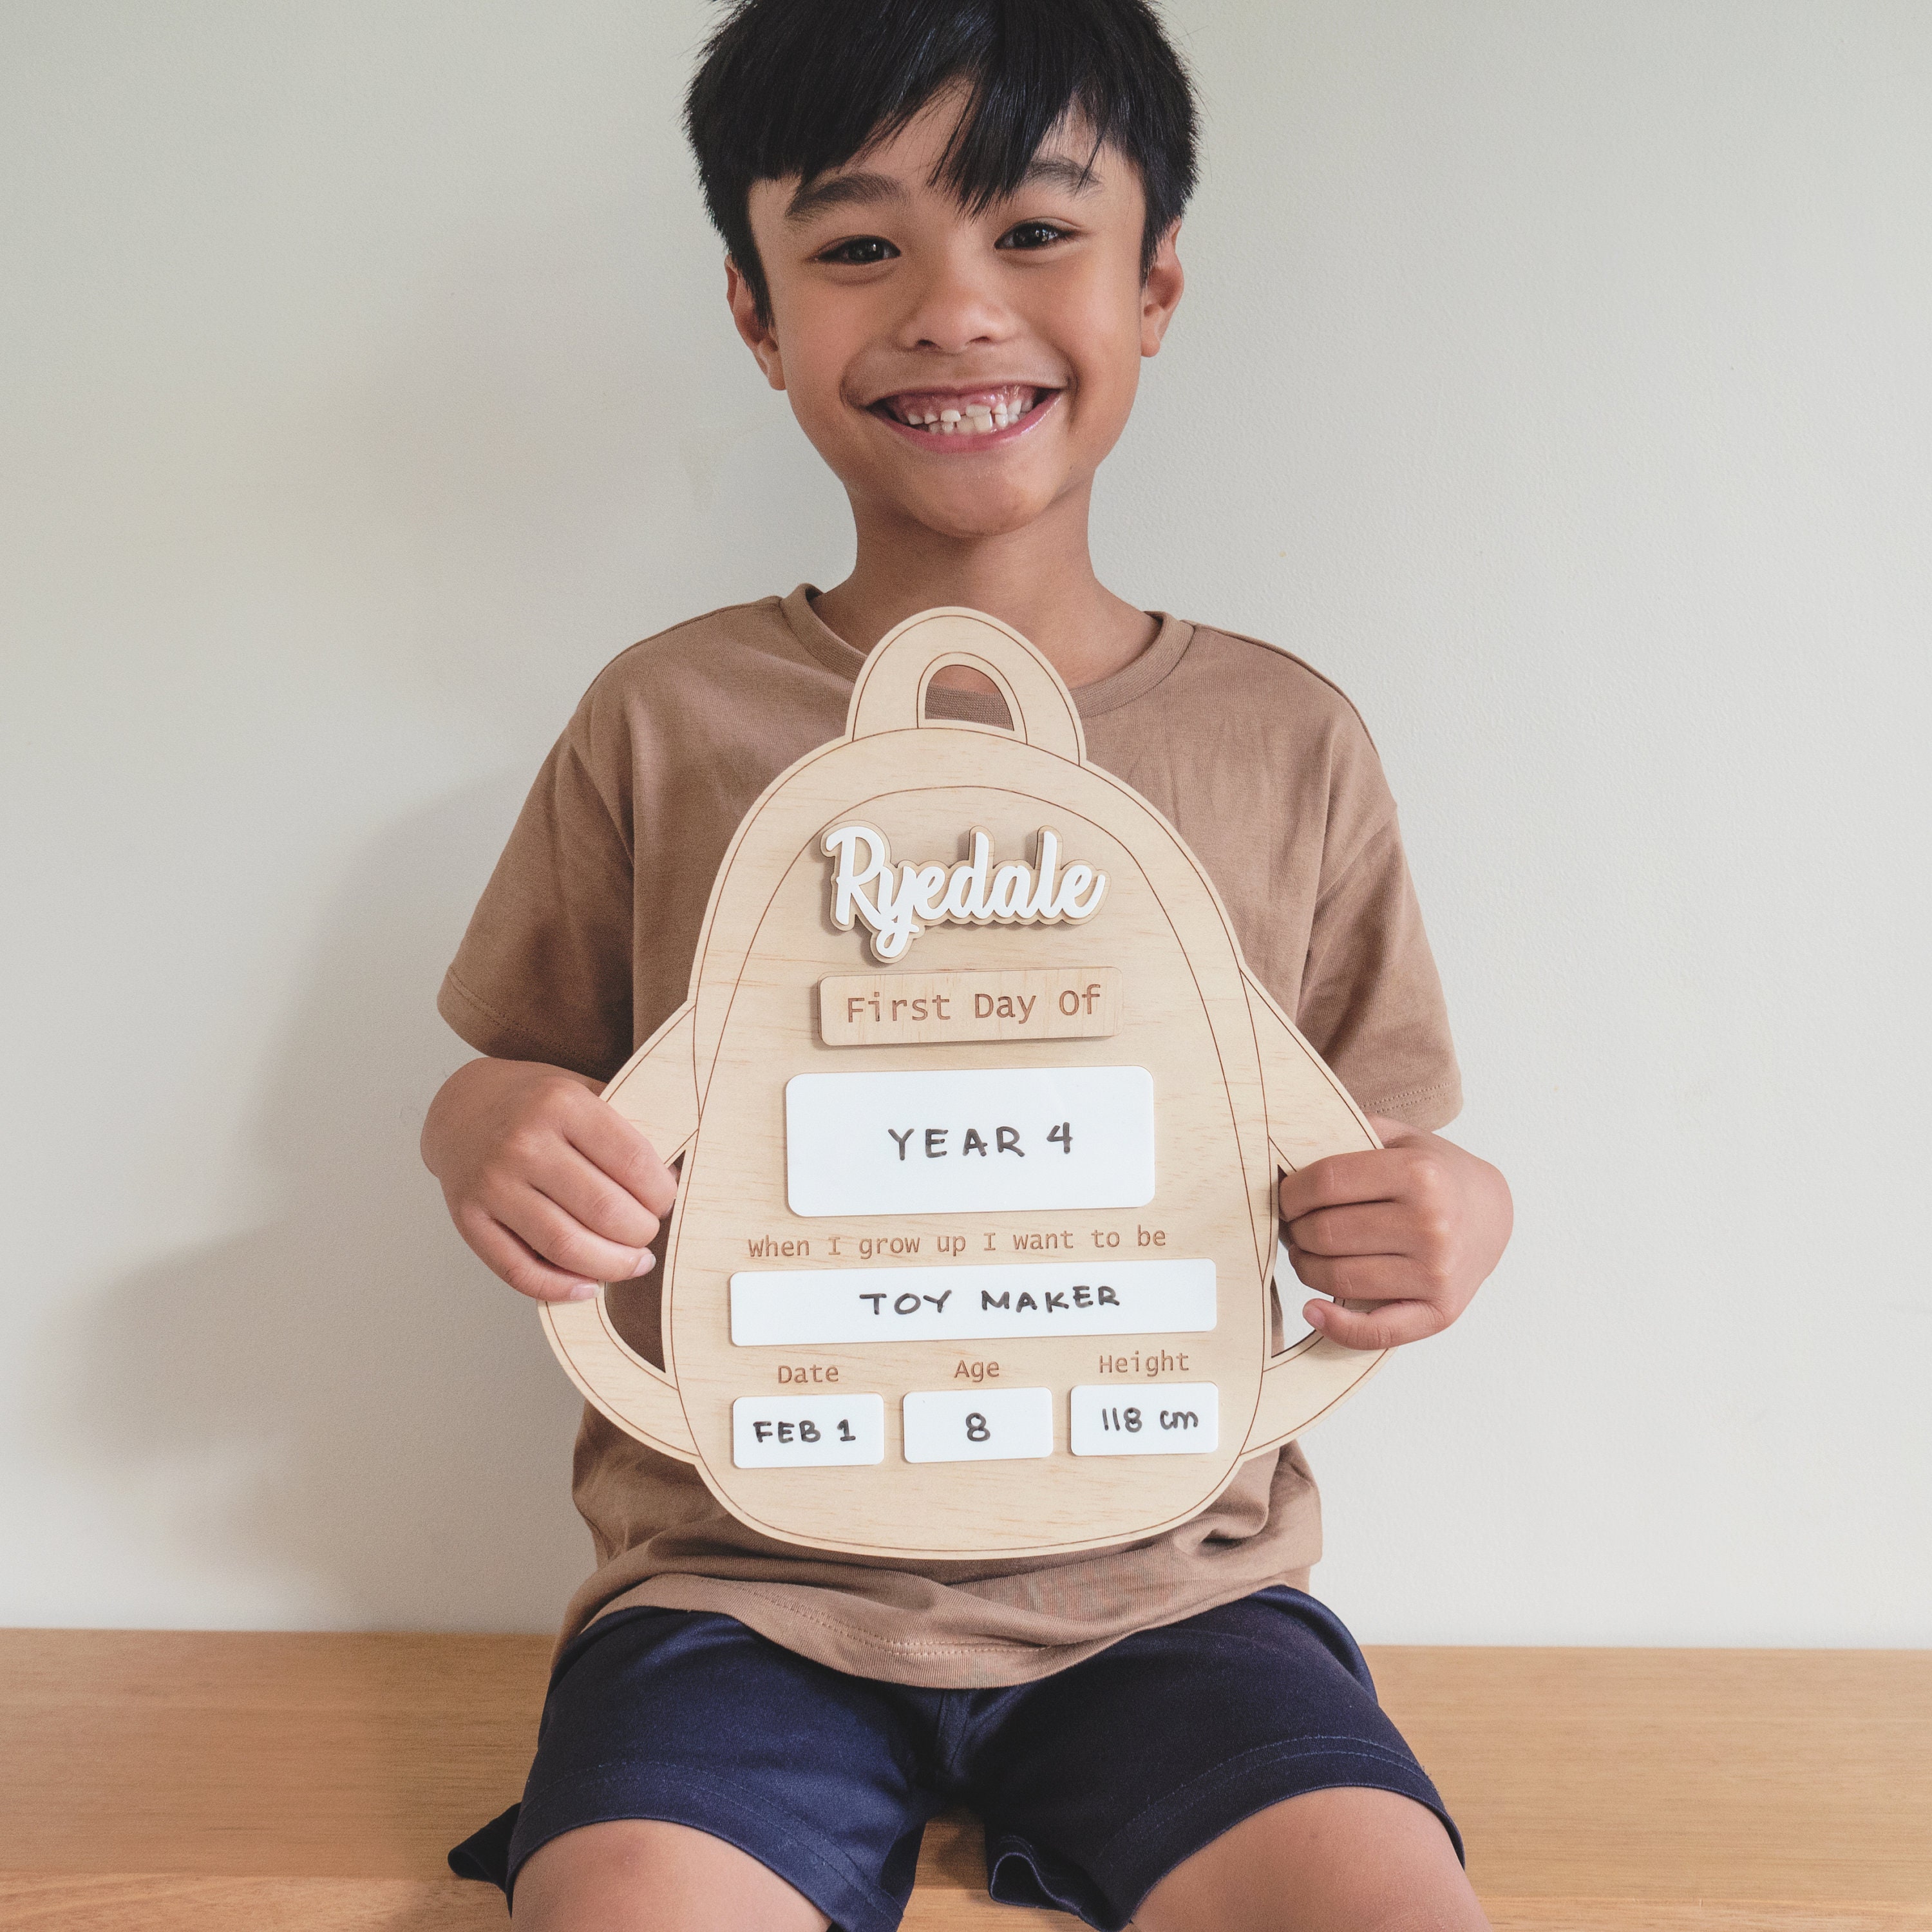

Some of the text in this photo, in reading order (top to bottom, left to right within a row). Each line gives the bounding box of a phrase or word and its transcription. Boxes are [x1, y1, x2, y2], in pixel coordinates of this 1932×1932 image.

[826, 826, 1106, 958] Ryedale
[847, 984, 1101, 1024] First Day Of
[887, 1122, 1073, 1160] YEAR 4
[828, 1236, 840, 1255] I
[858, 1238, 920, 1259] grow
[936, 1235, 966, 1256] up
[983, 1233, 996, 1251] I
[1012, 1230, 1074, 1249] want
[1090, 1228, 1120, 1247] to
[1137, 1225, 1166, 1246] be
[859, 1285, 1121, 1315] TOY MAKER
[778, 1365, 839, 1383] Date
[954, 1359, 1000, 1382] Age
[1099, 1349, 1189, 1376] Height
[753, 1419, 856, 1444] FEB 1
[965, 1413, 990, 1441] 8
[1101, 1408, 1198, 1432] 118 cm
